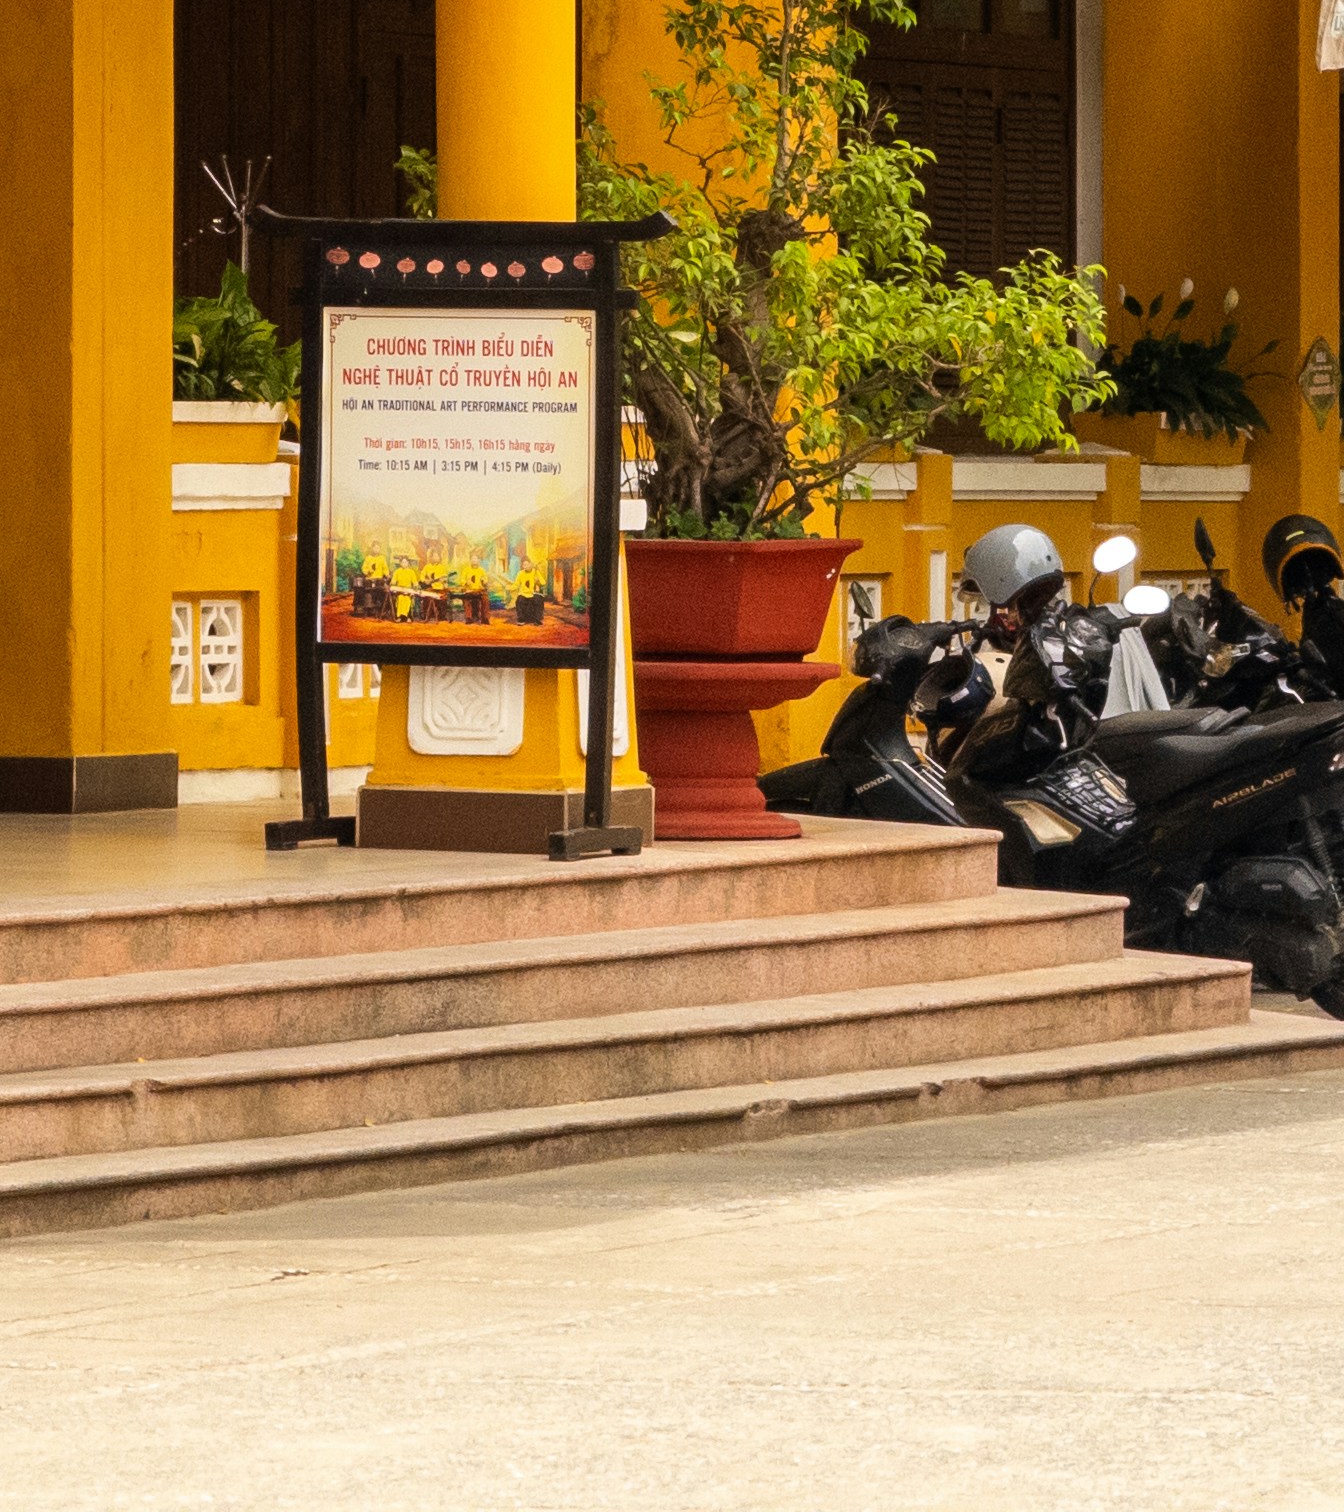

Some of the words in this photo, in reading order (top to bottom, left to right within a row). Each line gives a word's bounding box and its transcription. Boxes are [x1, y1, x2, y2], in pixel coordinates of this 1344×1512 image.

[366, 336, 427, 356] CHƯƠNG
[432, 335, 475, 356] TRÌNH
[482, 331, 514, 357] BIỂU
[520, 334, 554, 357] DIỄN
[342, 364, 381, 389] NGHỆ
[386, 365, 433, 390] THUẬT
[439, 361, 459, 387] CỔ
[464, 364, 521, 387] TRUYỀN
[527, 367, 552, 391] HỘI
[557, 370, 578, 388] AN
[342, 397, 358, 412] HỘI
[361, 399, 374, 411] AN
[377, 399, 437, 412] TRADITIONAL
[440, 400, 457, 412] ART
[461, 400, 529, 413] PERFORMANCE
[532, 402, 578, 413] PROGRAM
[411, 439, 441, 450] 10h15,
[445, 439, 475, 451] 15h15,
[479, 440, 506, 451] 16h15
[358, 458, 382, 471] Time:
[386, 459, 410, 471] 10:15
[413, 460, 428, 471] AM
[441, 460, 461, 472] 3:15
[464, 461, 479, 472] PM
[491, 461, 512, 473] 4:15
[515, 462, 529, 473] PM
[532, 462, 562, 475] (Daily)
[855, 773, 893, 795] HONDA
